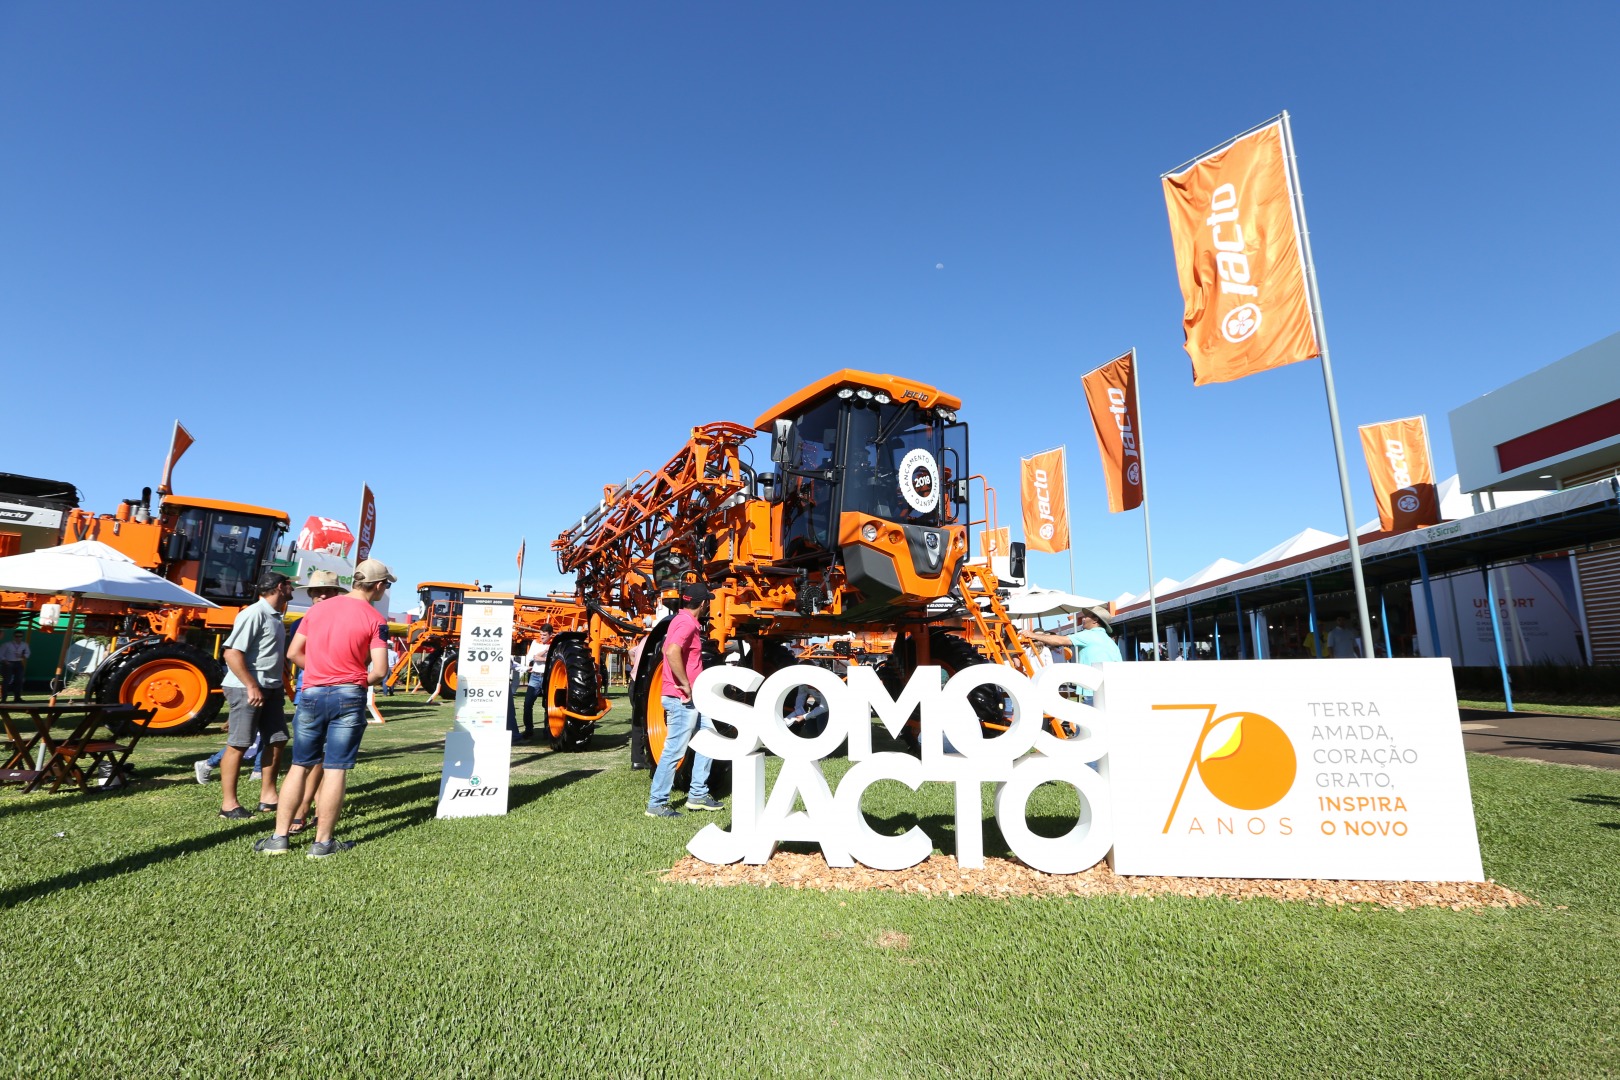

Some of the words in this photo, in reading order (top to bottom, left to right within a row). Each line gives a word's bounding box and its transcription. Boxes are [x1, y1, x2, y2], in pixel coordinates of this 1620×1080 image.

[1206, 183, 1258, 297] jacto
[900, 390, 928, 402] jacto
[1107, 387, 1139, 459] jacto
[1385, 439, 1418, 494] jacto
[914, 476, 931, 488] 2018
[1034, 469, 1055, 522] jacto
[1475, 608, 1509, 619] 450
[470, 626, 503, 638] 4x4
[467, 650, 504, 662] 30%
[463, 688, 484, 698] 198
[687, 663, 1110, 762] SOMOS
[1308, 702, 1380, 717] TERRA
[1312, 725, 1394, 742] AMADA,
[1313, 744, 1418, 768] CORAÇÃO
[1316, 772, 1395, 790] GRATO,
[449, 786, 499, 801] jacto
[1319, 796, 1408, 812] INSPIRA
[686, 752, 1114, 874] JACTO
[1188, 817, 1293, 836] ANOS
[1320, 820, 1337, 836] O
[1343, 820, 1408, 837] NOVO
